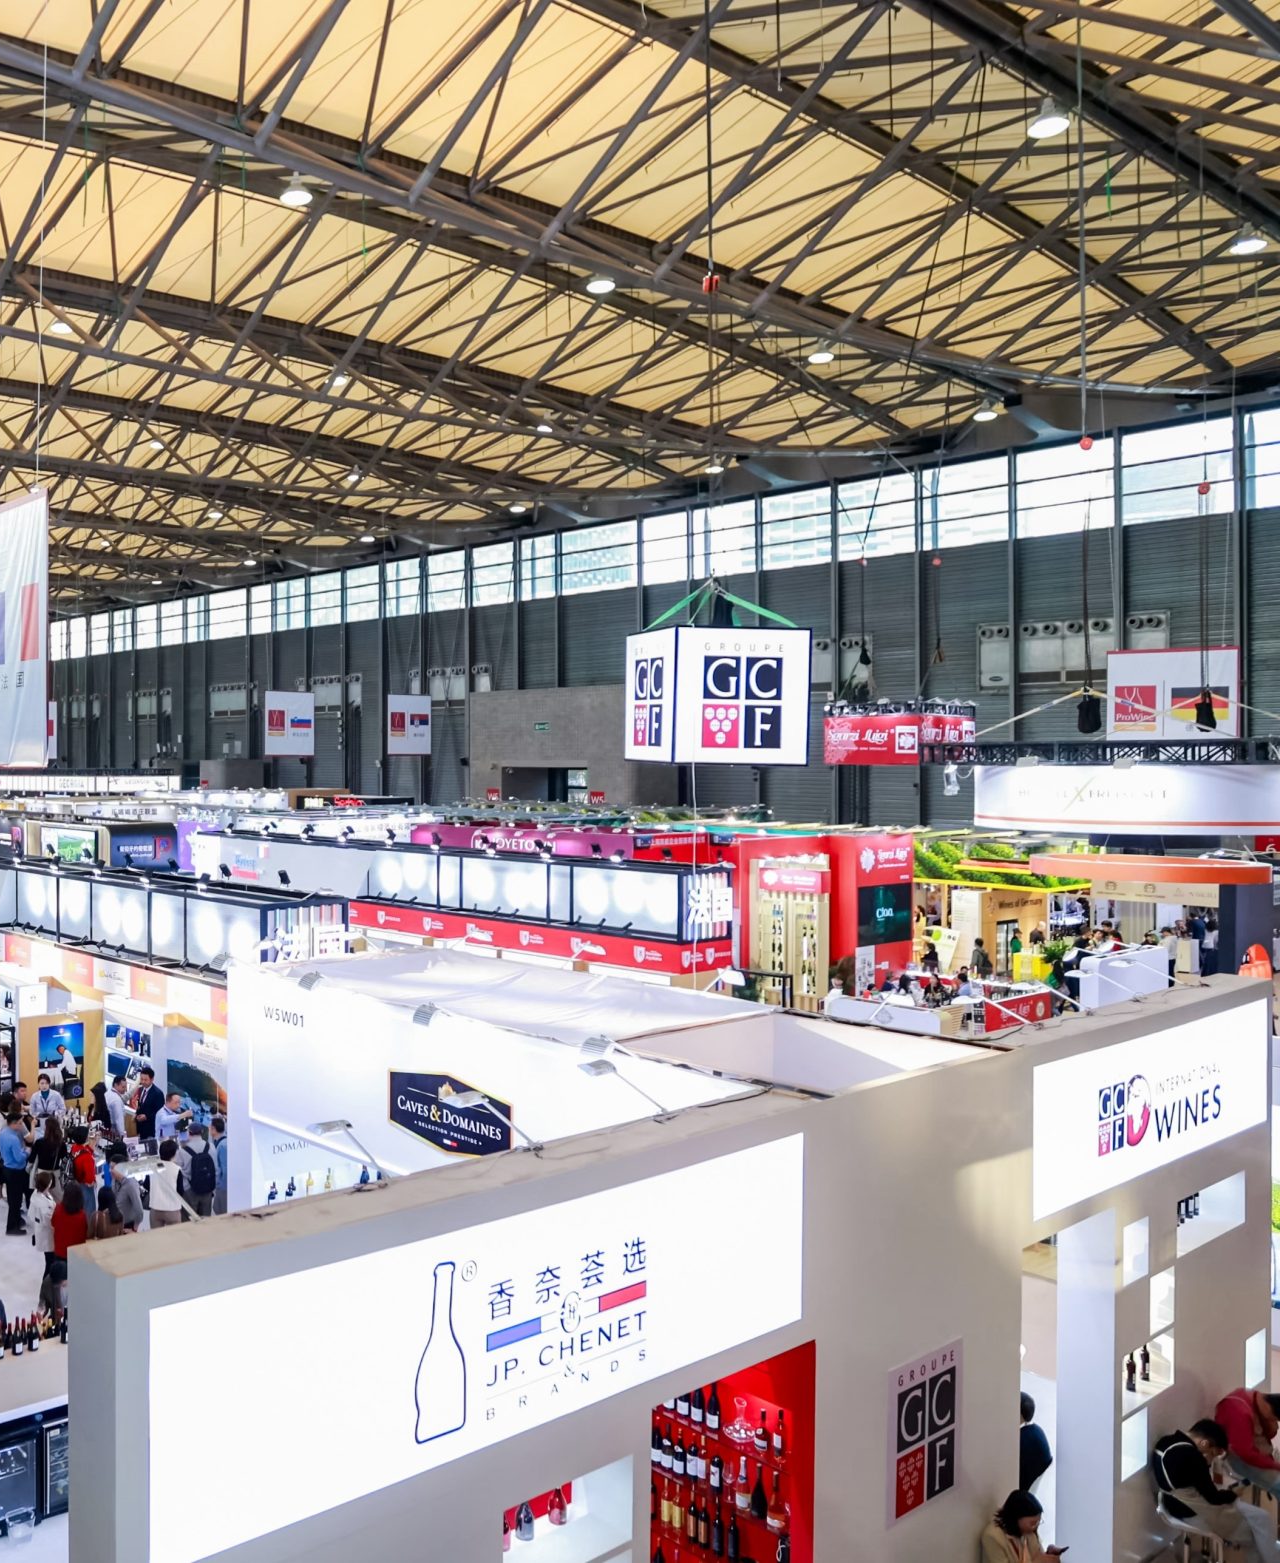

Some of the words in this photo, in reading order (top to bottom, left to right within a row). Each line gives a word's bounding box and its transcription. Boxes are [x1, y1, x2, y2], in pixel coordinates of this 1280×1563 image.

[704, 642, 784, 653] GROUPE
[753, 707, 774, 746] F
[1116, 713, 1155, 722] ProWine
[687, 887, 733, 924] 法国
[263, 1005, 305, 1028] W5W01
[397, 1095, 428, 1117] CAVES
[429, 1104, 441, 1123] &
[442, 1109, 502, 1141] DOMAINES
[418, 1121, 448, 1135] SELECTION
[450, 1131, 478, 1145] PRESTIGE
[1155, 1084, 1221, 1143] WINES
[488, 1238, 647, 1320] 香奈荟选
[486, 1357, 525, 1387] JP.
[538, 1311, 647, 1366] CHENET
[898, 1350, 955, 1386] GROUPE
[486, 1349, 647, 1421] BRANDS
[934, 1437, 949, 1491] F
